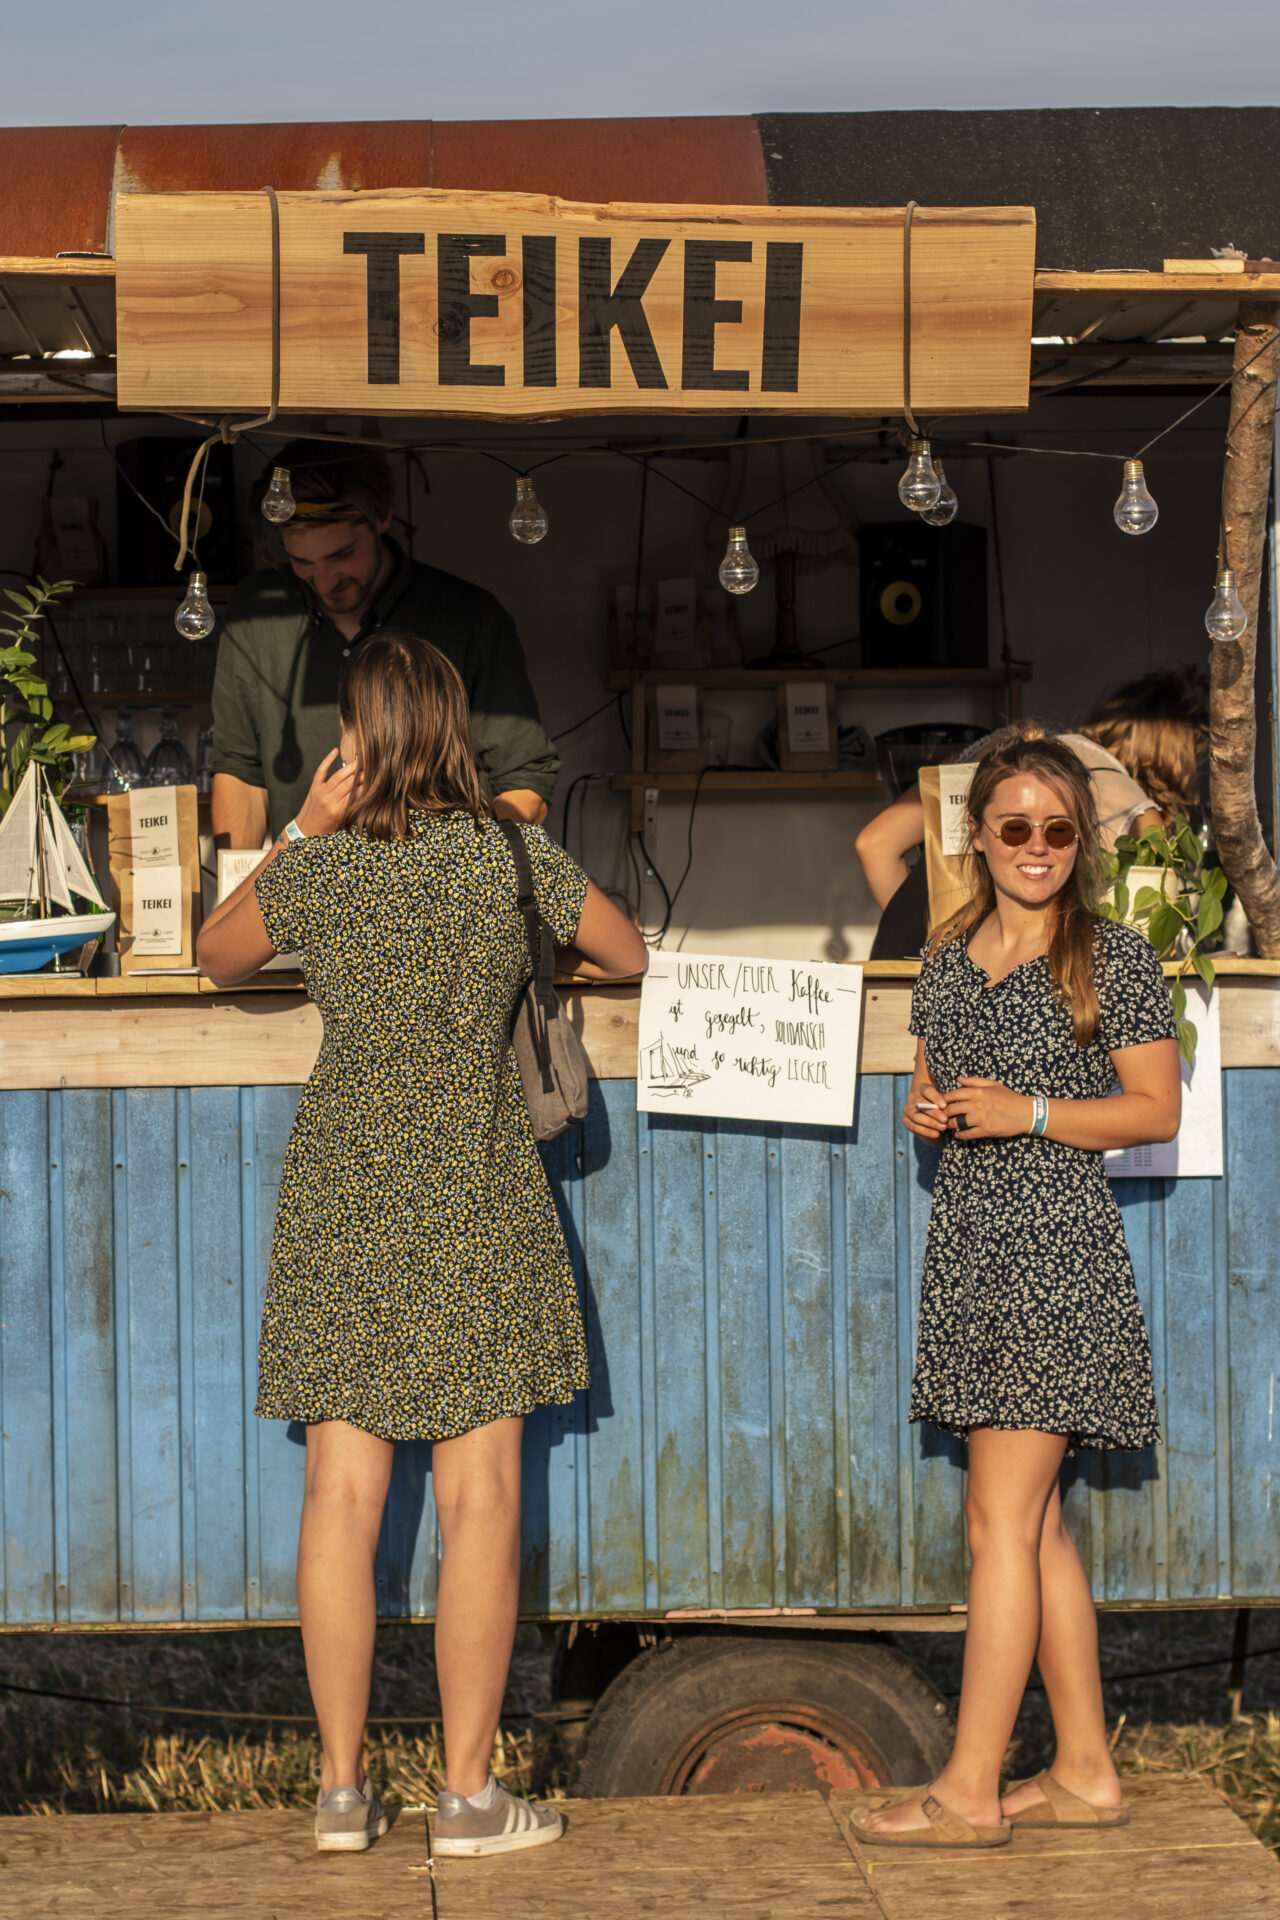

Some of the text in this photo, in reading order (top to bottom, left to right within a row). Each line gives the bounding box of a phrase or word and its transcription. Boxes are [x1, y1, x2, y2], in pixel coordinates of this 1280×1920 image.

[342, 231, 804, 392] TEIKEI
[138, 815, 168, 829] TEIKEI
[141, 898, 172, 910] TEIKEI
[788, 968, 834, 1016] Kaffee
[674, 1043, 832, 1090] und so richtig LECKER
